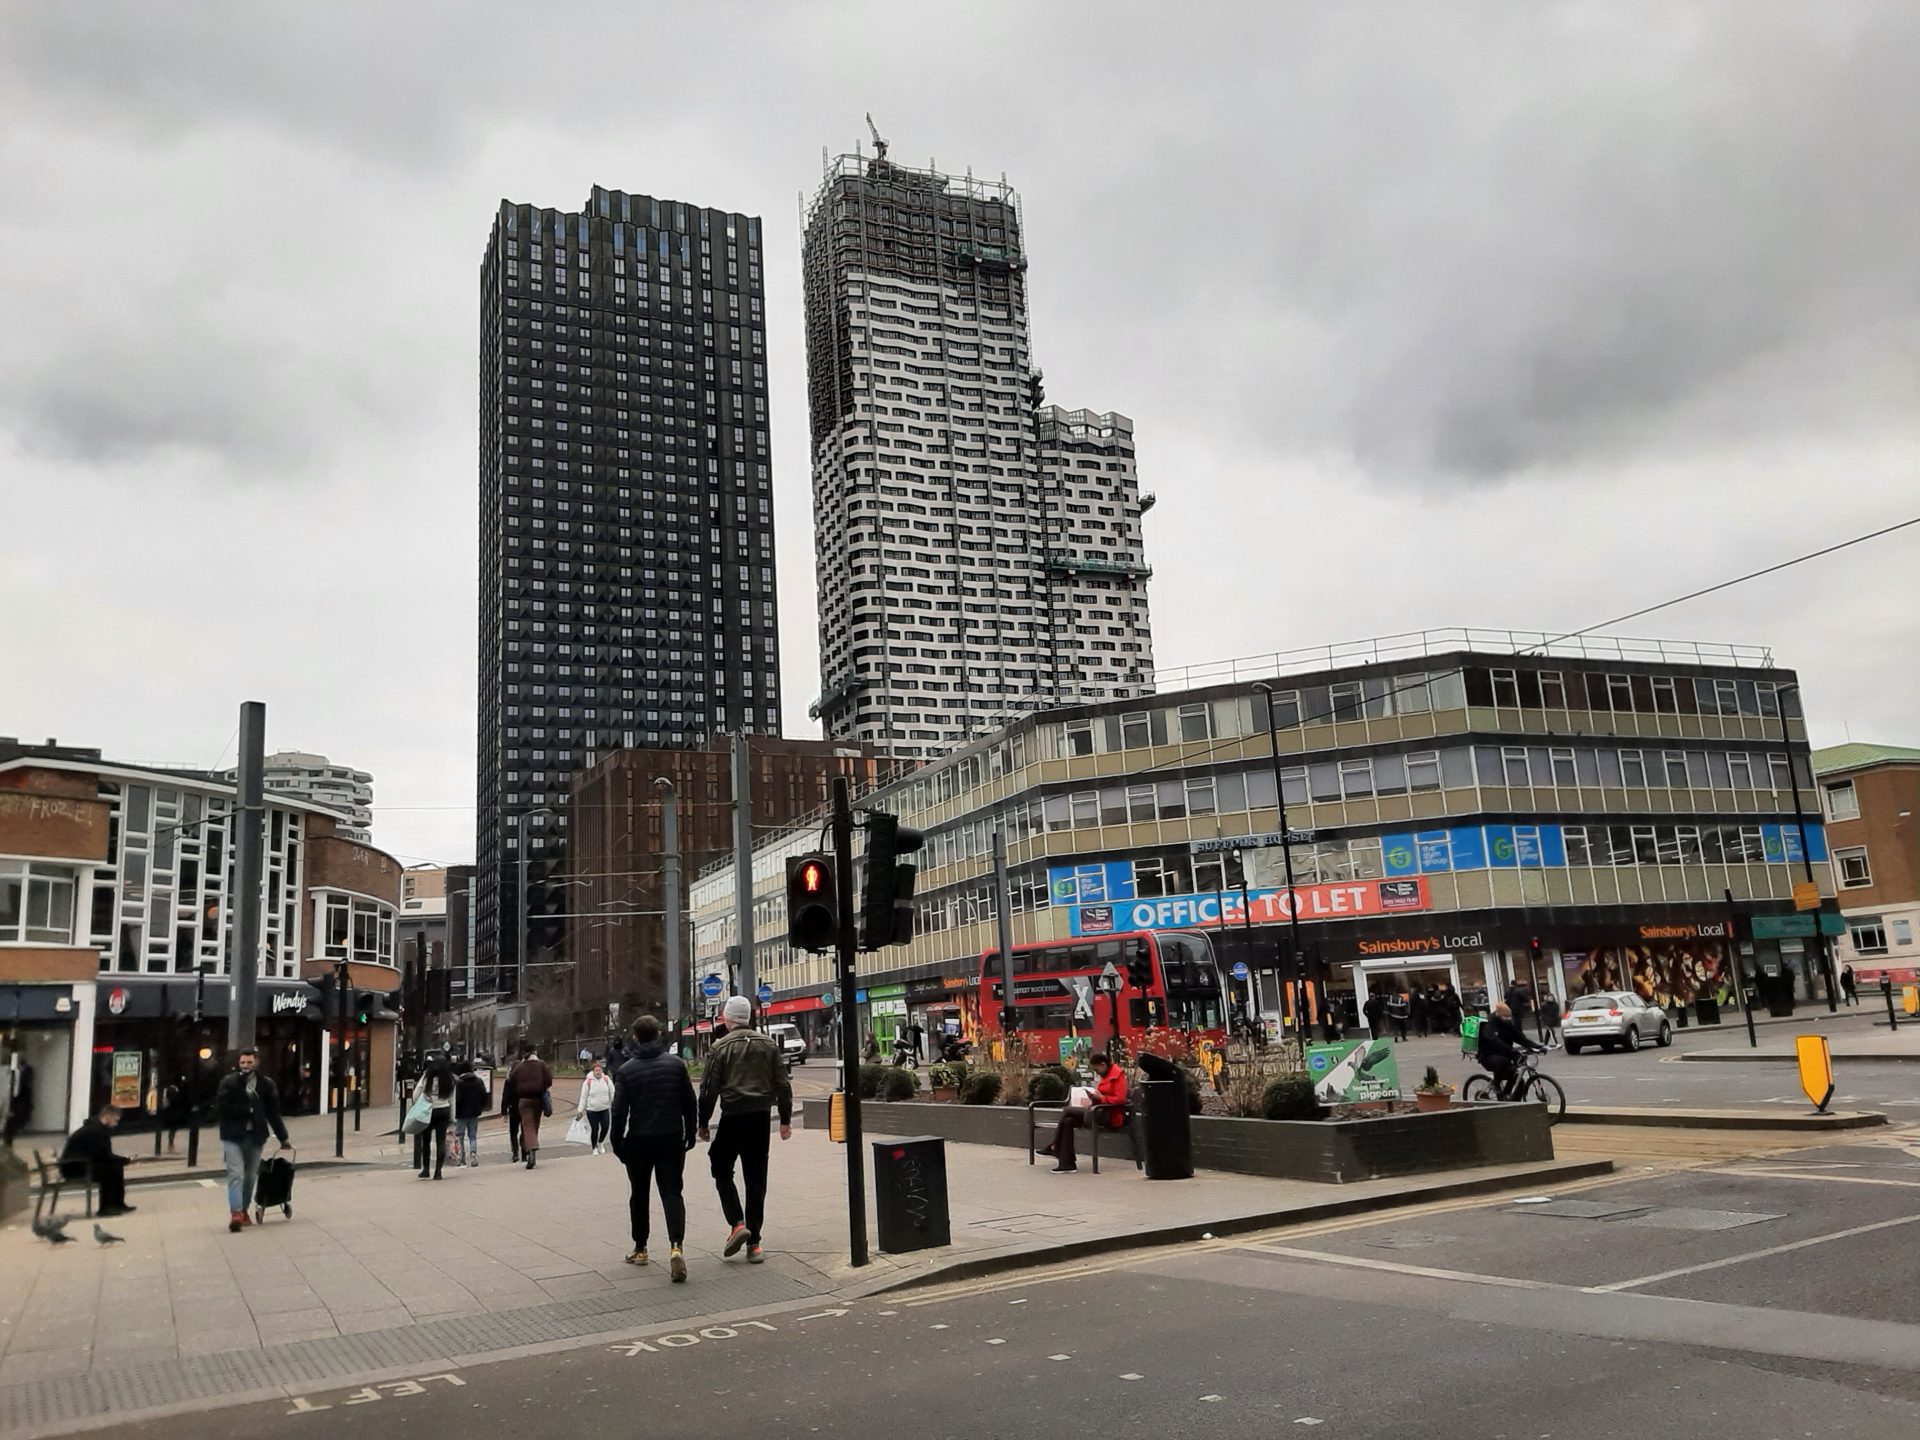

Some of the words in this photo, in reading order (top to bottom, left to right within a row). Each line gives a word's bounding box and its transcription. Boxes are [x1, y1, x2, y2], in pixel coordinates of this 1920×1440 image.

[1132, 894, 1253, 927] OFFICES
[1259, 888, 1304, 917] TO
[1311, 886, 1367, 914] LET
[1358, 936, 1440, 955] Sainsbury's
[1443, 931, 1484, 949] Local
[1640, 925, 1697, 940] Sainsbury's
[1697, 922, 1724, 937] Local
[273, 990, 308, 1014] Wendy's
[1360, 1089, 1400, 1100] pigeons
[610, 1321, 778, 1357] LOOK
[286, 1373, 467, 1416] LEFT
